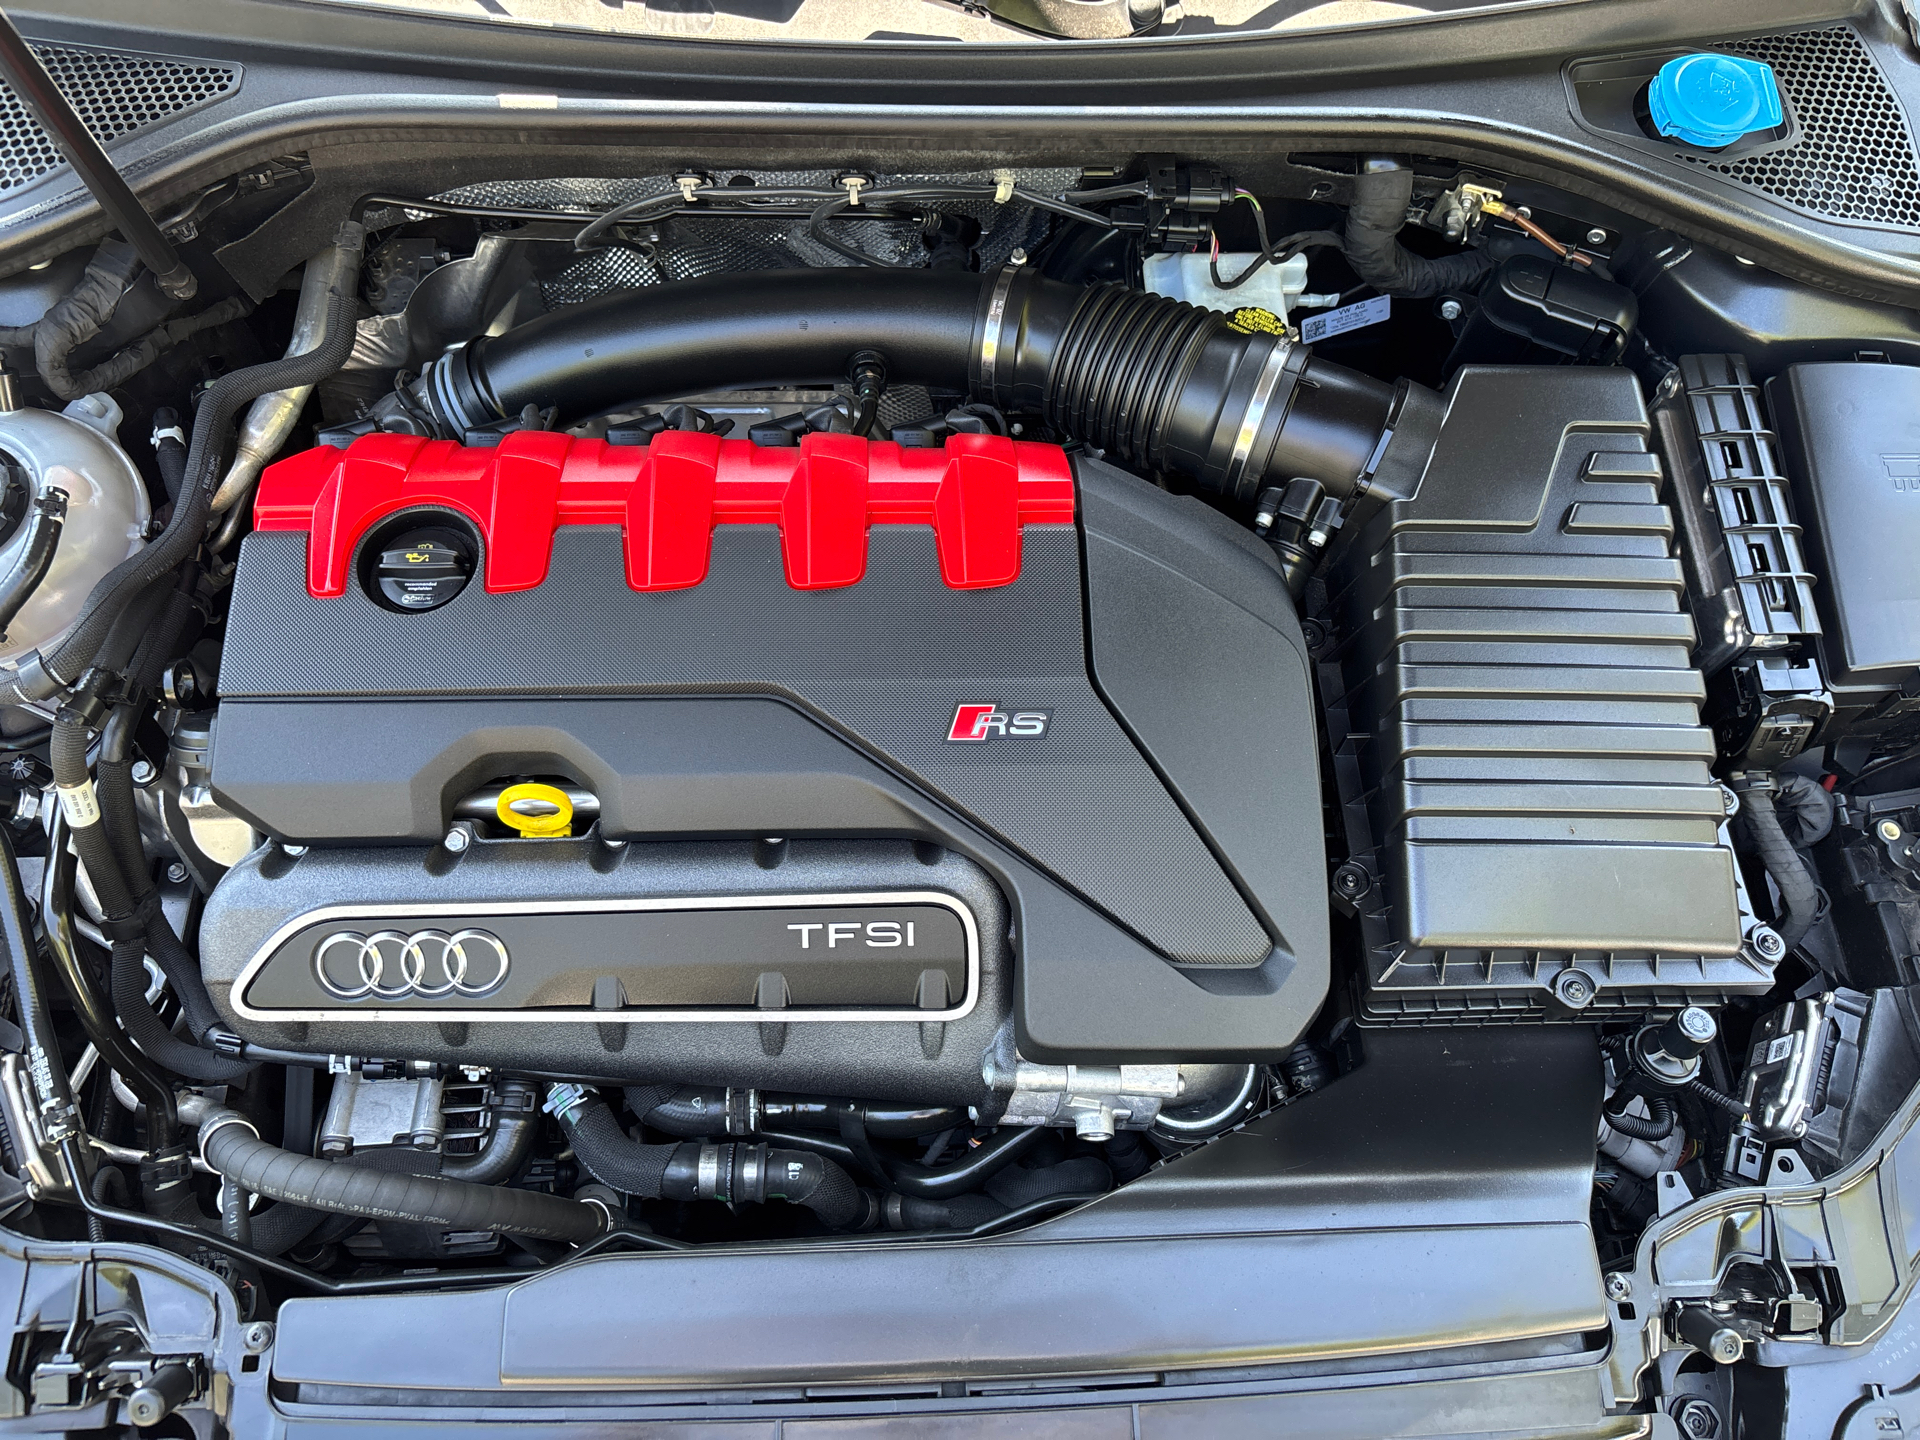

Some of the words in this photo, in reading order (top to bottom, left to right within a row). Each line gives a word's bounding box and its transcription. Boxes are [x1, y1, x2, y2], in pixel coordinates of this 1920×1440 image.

[1338, 306, 1351, 316] VW
[970, 712, 1046, 736] RS
[787, 921, 915, 949] TFSI
